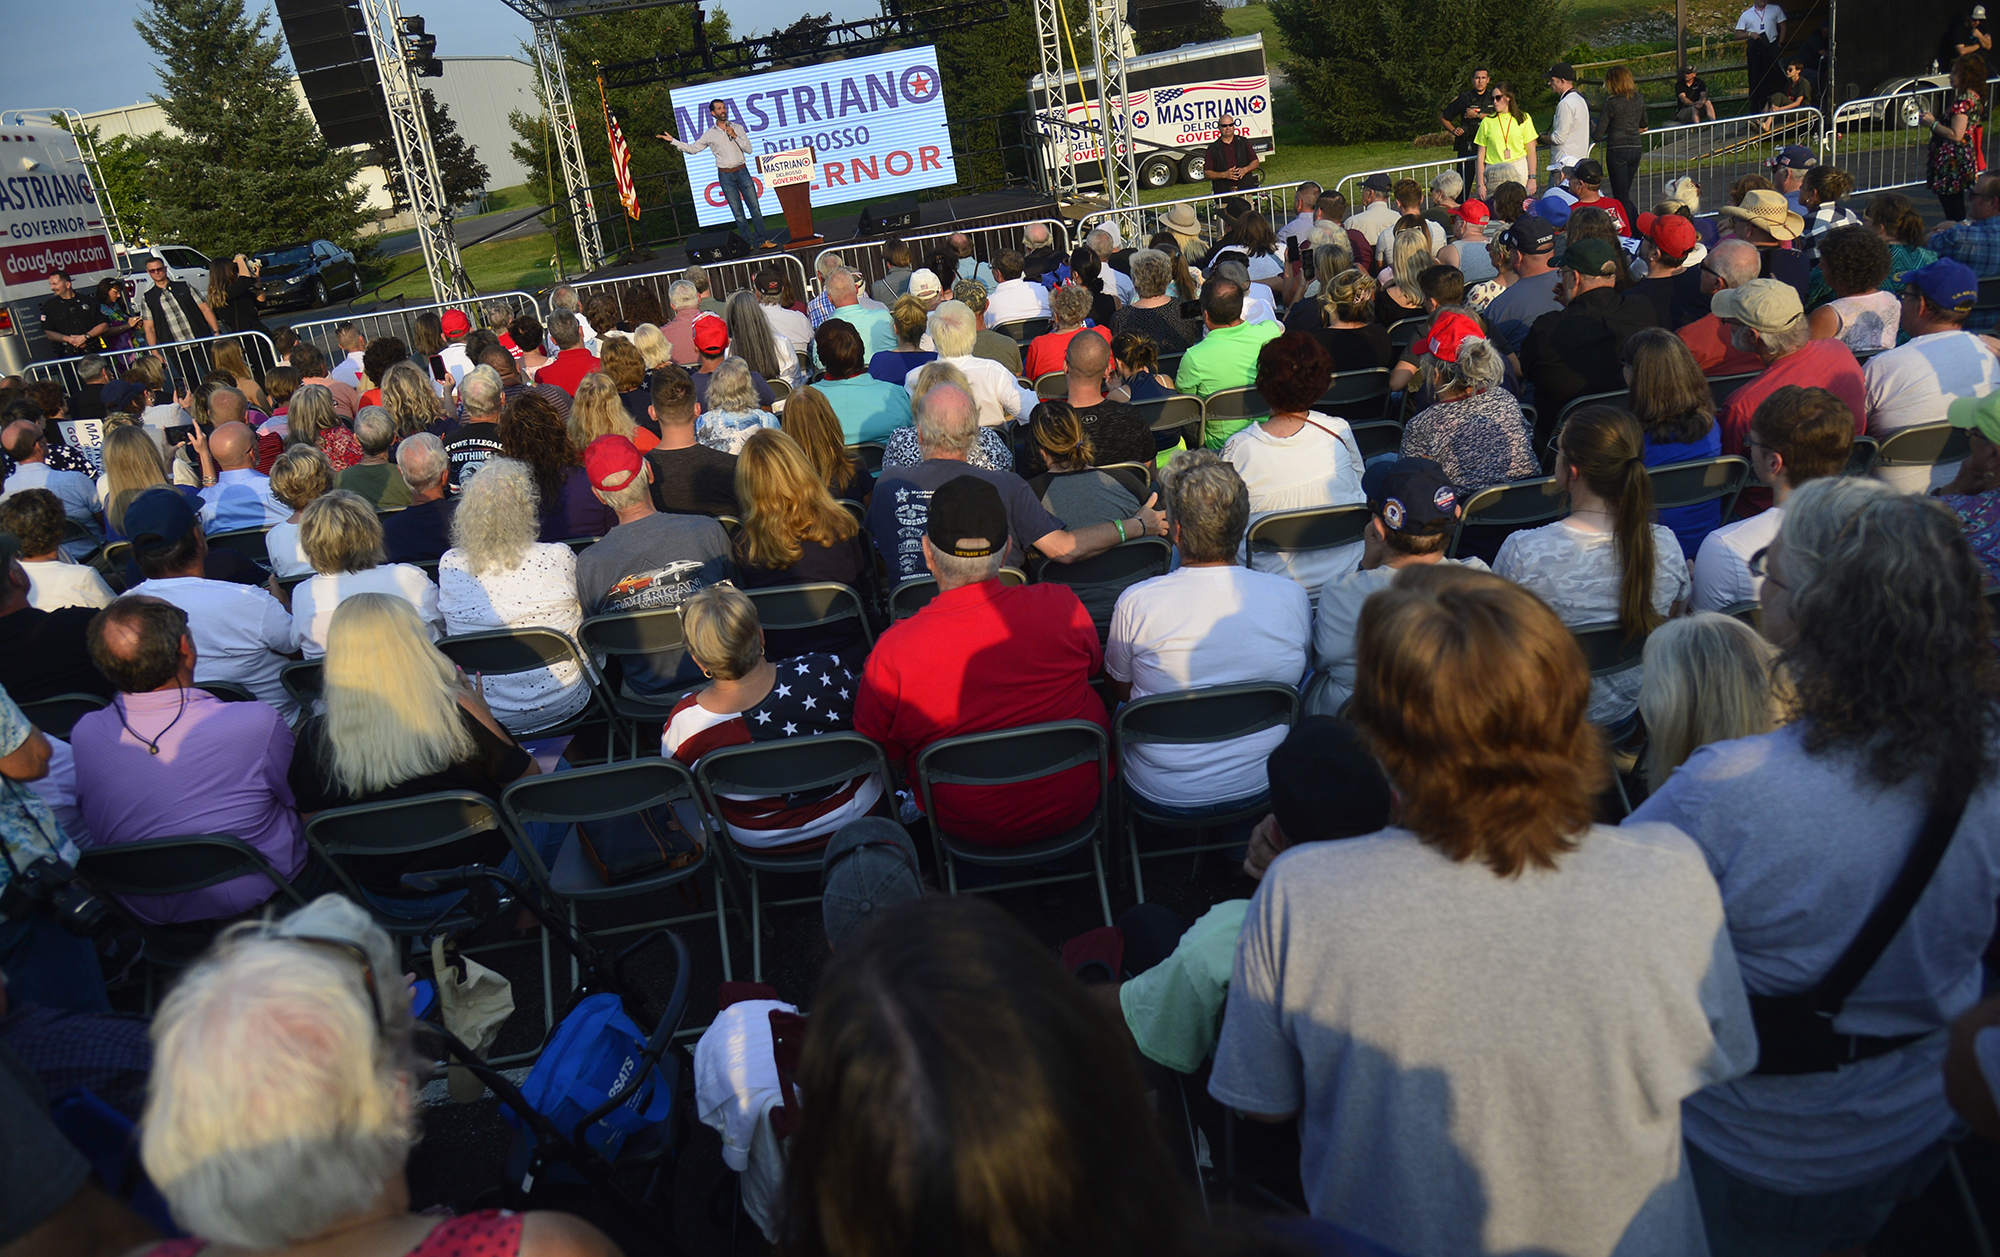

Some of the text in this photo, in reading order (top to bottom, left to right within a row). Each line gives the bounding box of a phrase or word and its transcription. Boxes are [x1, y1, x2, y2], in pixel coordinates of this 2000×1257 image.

[1157, 94, 1267, 125] MASTRIANO
[1183, 118, 1242, 133] DELROO
[1176, 127, 1251, 144] GOVEROR
[763, 157, 811, 174] MASTRIANO
[772, 174, 808, 186] GOVERNOR
[0, 173, 96, 212] ASTRIANO
[10, 217, 86, 239] GOVERNOR
[6, 246, 106, 274] doug4gov.com
[451, 439, 468, 449] OWE
[452, 450, 491, 462] NOTHING
[612, 578, 703, 611] AMERICAN
[640, 593, 682, 610] MADE
